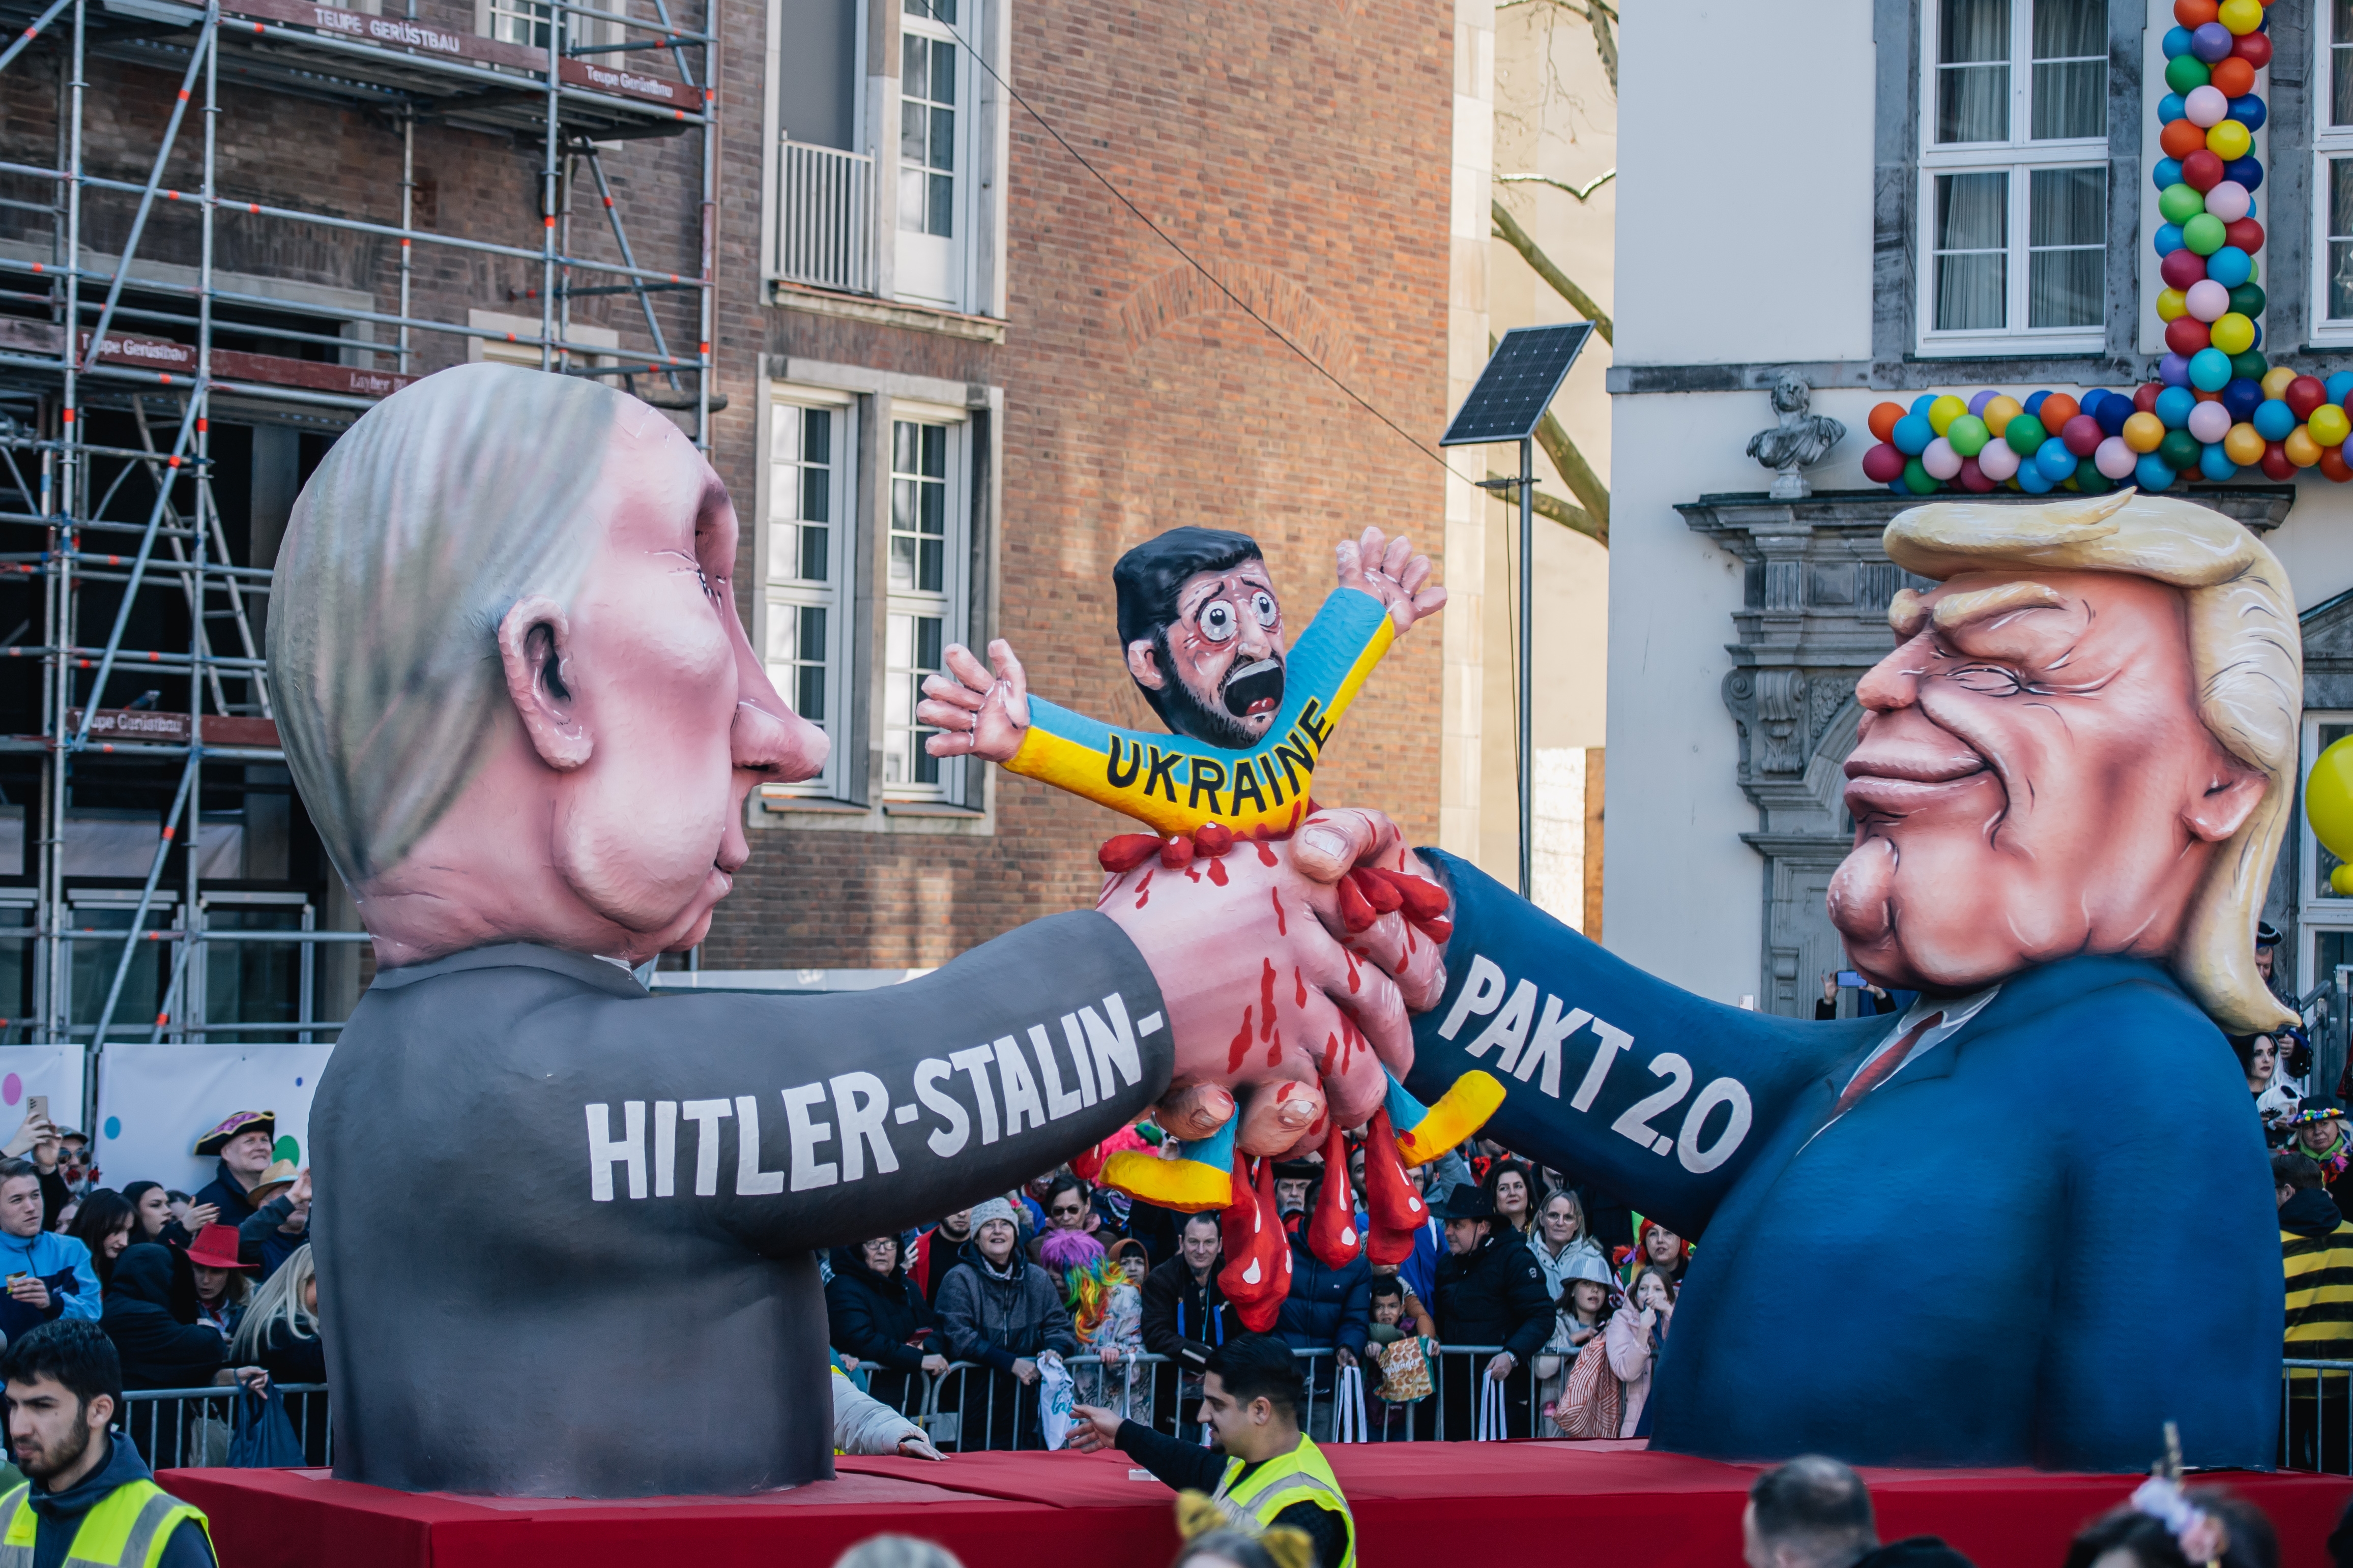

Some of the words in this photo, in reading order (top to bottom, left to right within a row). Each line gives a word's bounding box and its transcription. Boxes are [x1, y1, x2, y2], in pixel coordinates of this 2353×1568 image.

[314, 8, 363, 34] TEUPE
[369, 19, 460, 52] GERÜSTBAU
[82, 334, 122, 354] Tupe
[74, 711, 115, 732] Tupe
[1107, 696, 1334, 817] UKRAINE
[1437, 954, 1635, 1113] PAKT
[1611, 1052, 1752, 1174] 2.0
